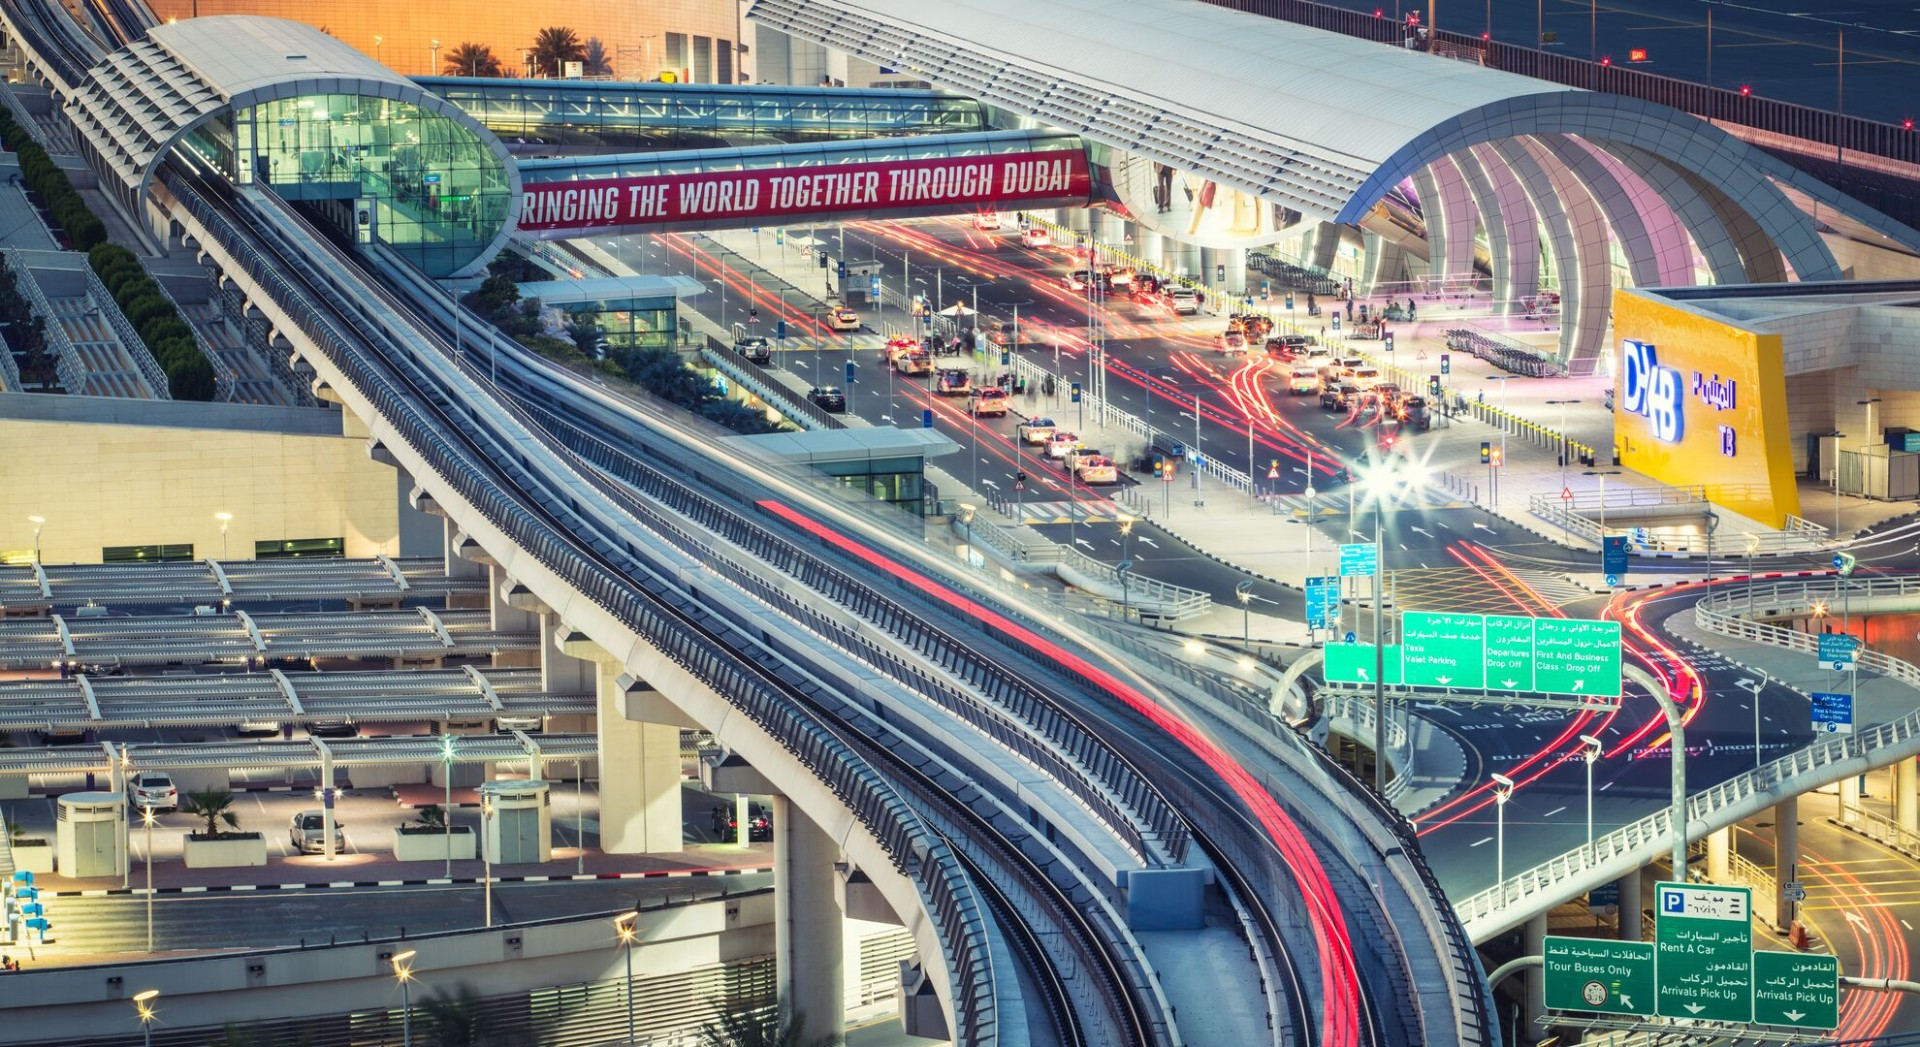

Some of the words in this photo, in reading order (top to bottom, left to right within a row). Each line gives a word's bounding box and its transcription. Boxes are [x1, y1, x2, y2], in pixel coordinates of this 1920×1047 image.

[520, 187, 619, 224] RINGING
[629, 184, 669, 218] THE
[680, 178, 760, 215] WORLD
[769, 171, 879, 209] TOGETHER
[888, 163, 994, 202] THROUGH
[1002, 158, 1072, 195] DUBAI
[1718, 424, 1736, 457] T3
[1405, 643, 1424, 653] Taxis
[1487, 647, 1530, 659] Departures
[1405, 655, 1426, 664] Valet
[1428, 656, 1457, 667] Parking
[1536, 650, 1554, 660] First
[1556, 651, 1572, 660] And
[1574, 651, 1609, 662] Business
[1487, 658, 1506, 669] Drop
[1508, 660, 1523, 668] Off
[1536, 661, 1560, 671] Class
[1566, 663, 1585, 673] Drop
[1587, 664, 1601, 673] Off
[1460, 723, 1505, 731] BUS
[1668, 894, 1680, 911] P
[1676, 930, 1720, 942] السيارات
[1721, 931, 1748, 944] تأجير
[1547, 945, 1569, 955] فقط
[1571, 946, 1609, 959] السياحية
[1611, 949, 1651, 960] الحافلات
[1660, 942, 1684, 953] Rent
[1687, 944, 1695, 954] A
[1697, 944, 1716, 955] Car
[1548, 960, 1571, 972] Tour
[1574, 962, 1605, 974] Buses
[1607, 964, 1632, 978] Only
[1705, 961, 1748, 972] القادمون
[1791, 962, 1835, 972] القادمون
[1680, 973, 1713, 986] الركاب
[1716, 975, 1748, 987] تحميل
[1765, 976, 1800, 988] الركاب
[1802, 978, 1835, 990] تحميل
[1661, 985, 1698, 998] Arrivals
[1700, 987, 1721, 999] Pick
[1723, 989, 1738, 1001] Up
[1756, 988, 1793, 1001] Arrivals
[1796, 991, 1817, 1002] Pick
[1819, 993, 1834, 1005] Up
